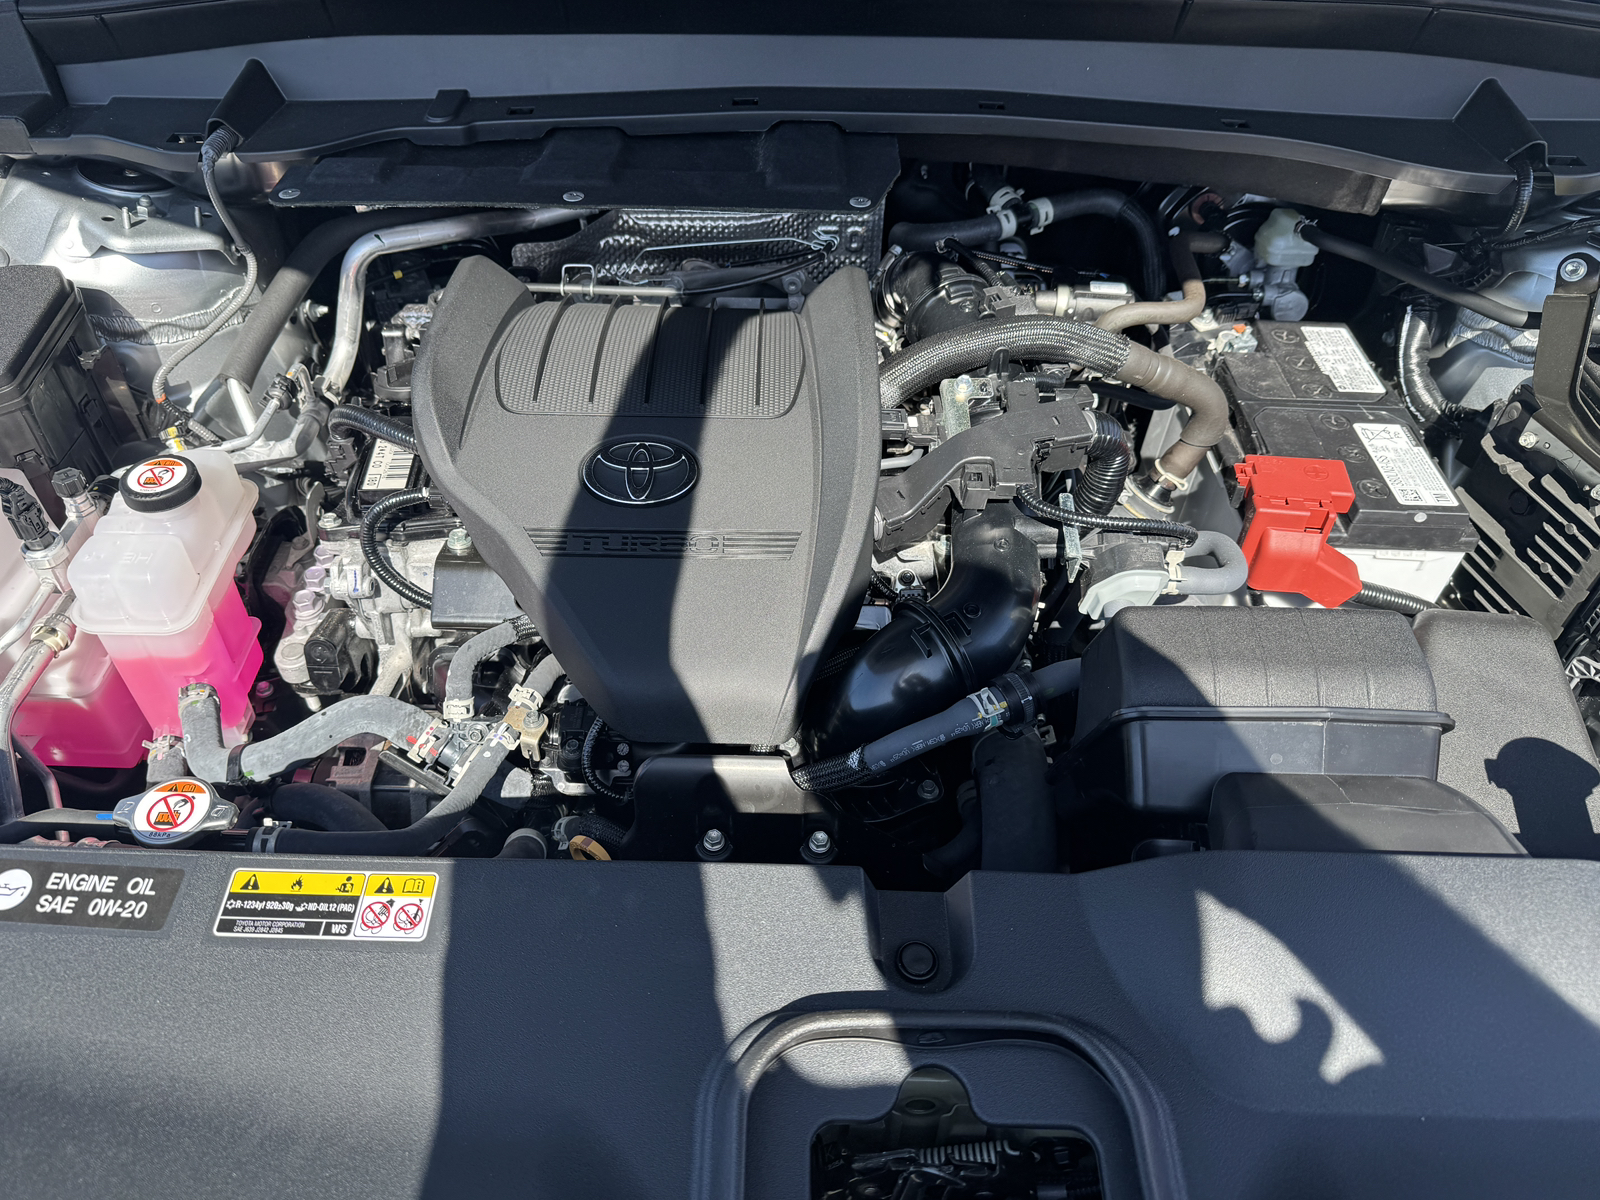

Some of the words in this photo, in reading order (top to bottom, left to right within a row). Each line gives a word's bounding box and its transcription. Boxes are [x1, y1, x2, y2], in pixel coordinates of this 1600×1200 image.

[46, 872, 118, 893] ENGINE
[126, 877, 156, 896] OIL
[35, 894, 79, 914] SAE
[87, 898, 148, 919] 0W-20
[331, 923, 348, 935] WS
